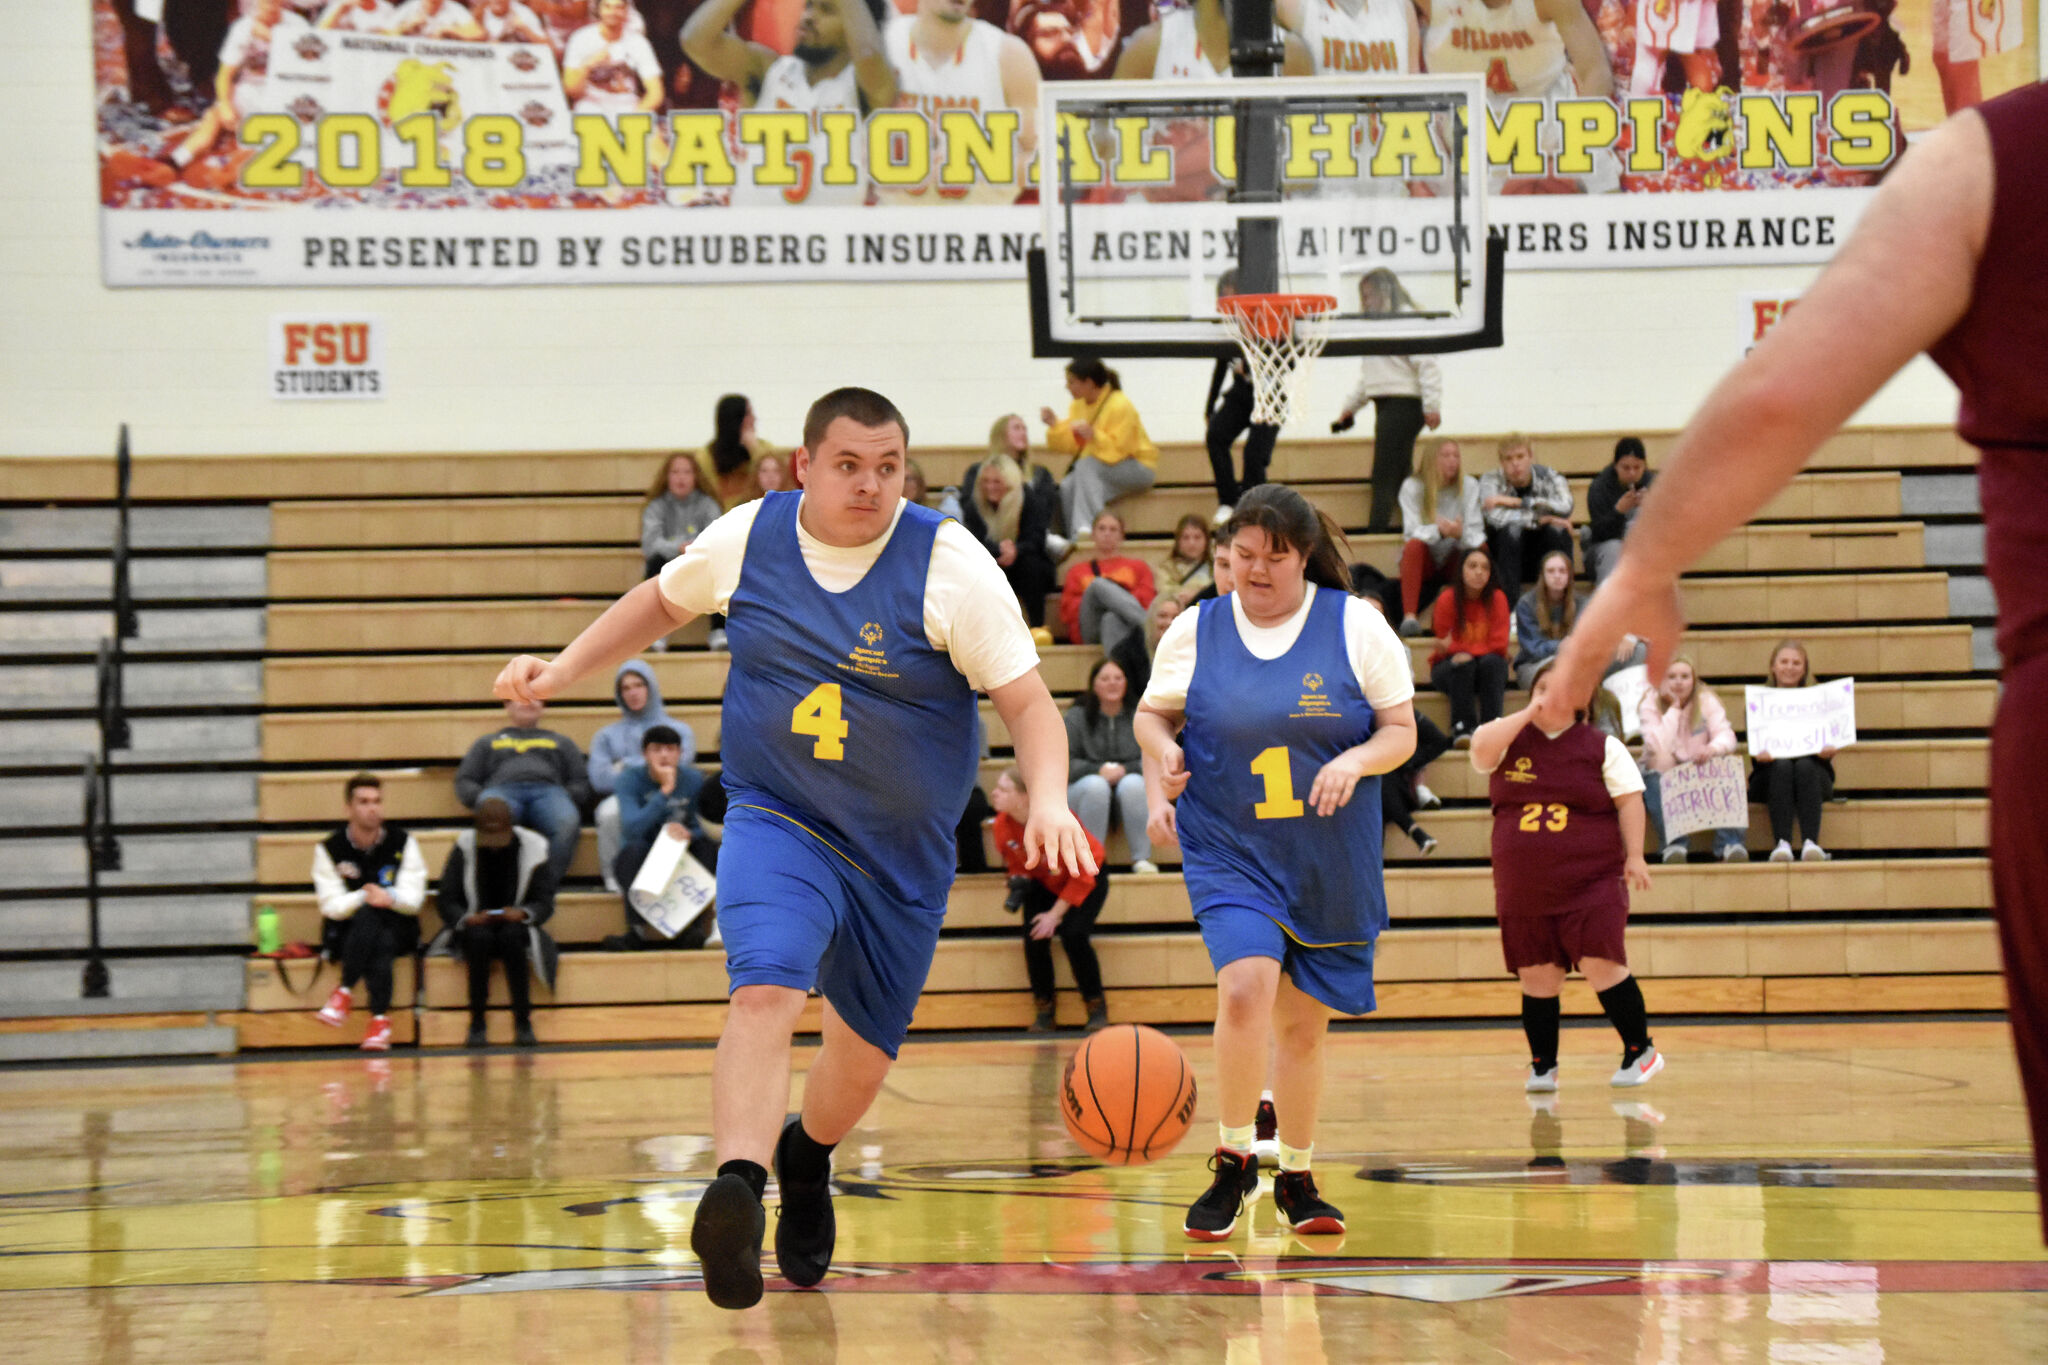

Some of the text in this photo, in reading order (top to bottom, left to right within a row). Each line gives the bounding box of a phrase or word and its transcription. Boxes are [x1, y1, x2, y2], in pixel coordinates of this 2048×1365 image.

[240, 87, 1896, 188] 2018 NATIONAL HAMPINS
[304, 238, 539, 269] PRESENTED
[558, 237, 605, 268] BY
[621, 234, 827, 267] SCHUBERG
[1607, 216, 1836, 251] INSURANCE
[282, 321, 370, 367] FSU
[274, 368, 382, 395] STUDENTS
[791, 682, 849, 761] 4
[1250, 745, 1305, 820] 1
[1519, 803, 1569, 832] 23
